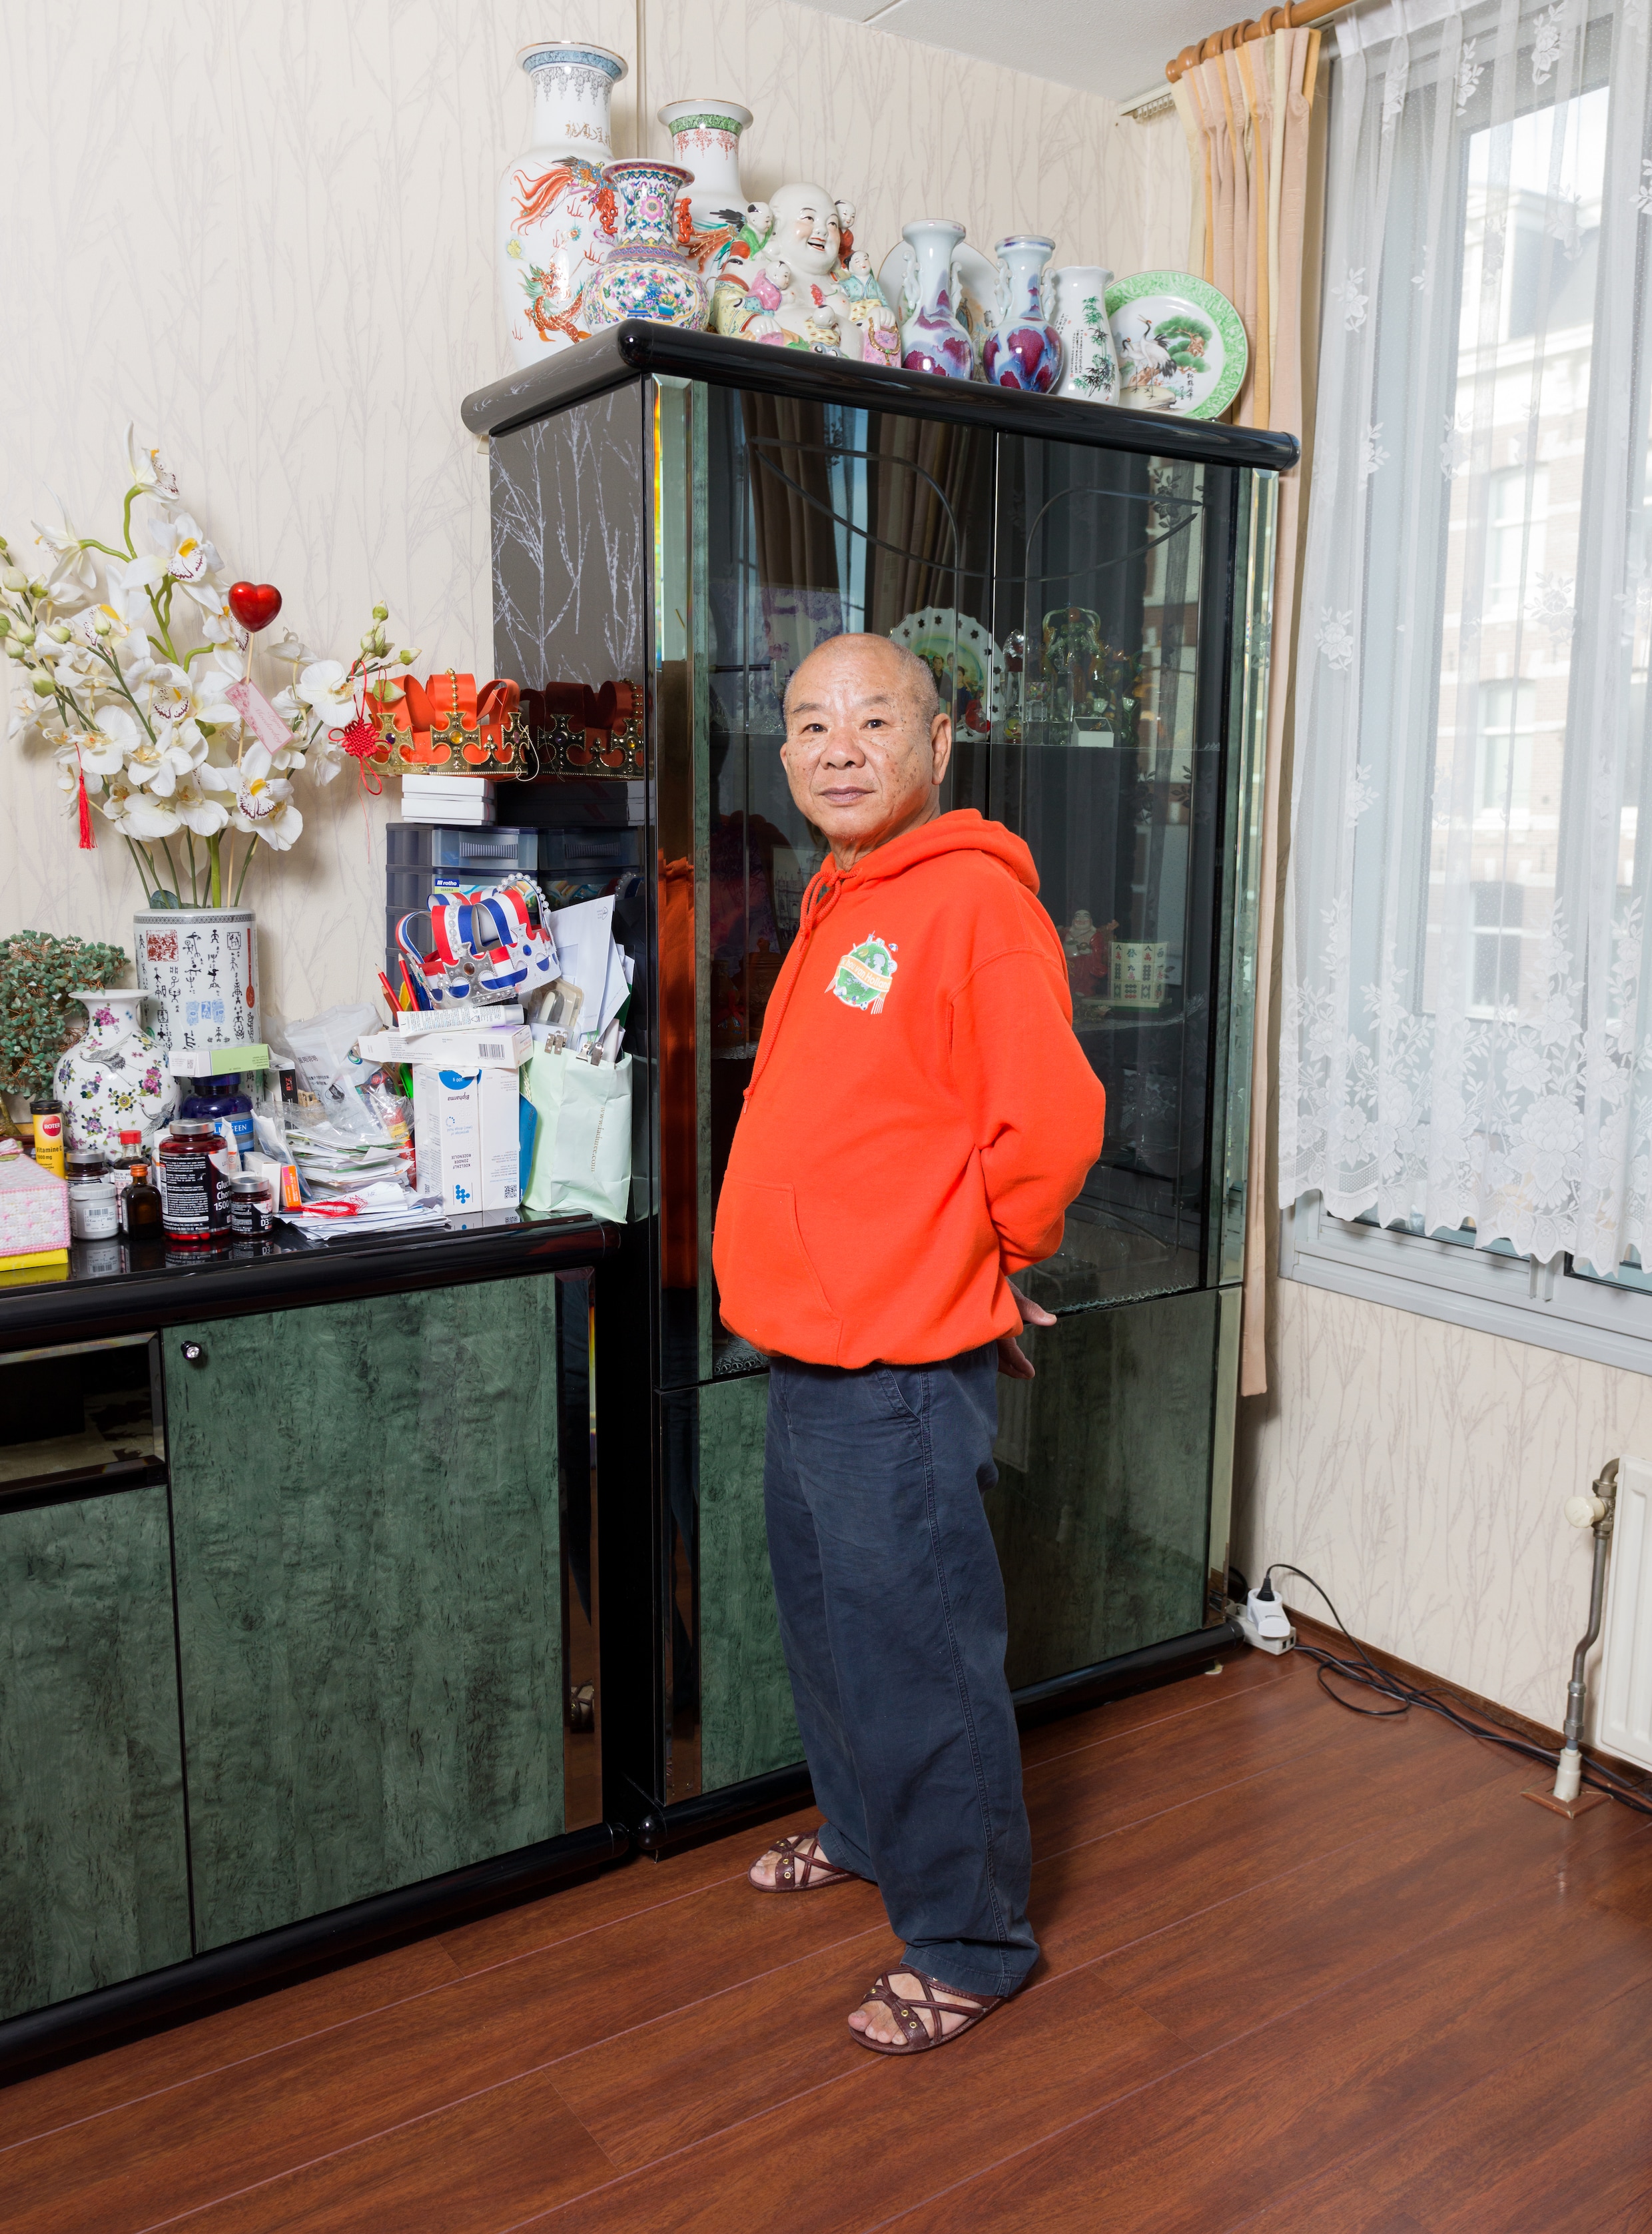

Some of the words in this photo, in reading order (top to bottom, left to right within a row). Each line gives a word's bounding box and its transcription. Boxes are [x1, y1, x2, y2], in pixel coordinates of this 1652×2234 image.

[1127, 949, 1137, 957] 發
[846, 959, 855, 969] hou
[855, 965, 865, 979] van
[864, 974, 890, 989] Holland
[448, 1092, 470, 1101] Bipharma
[214, 1200, 229, 1211] 1500
